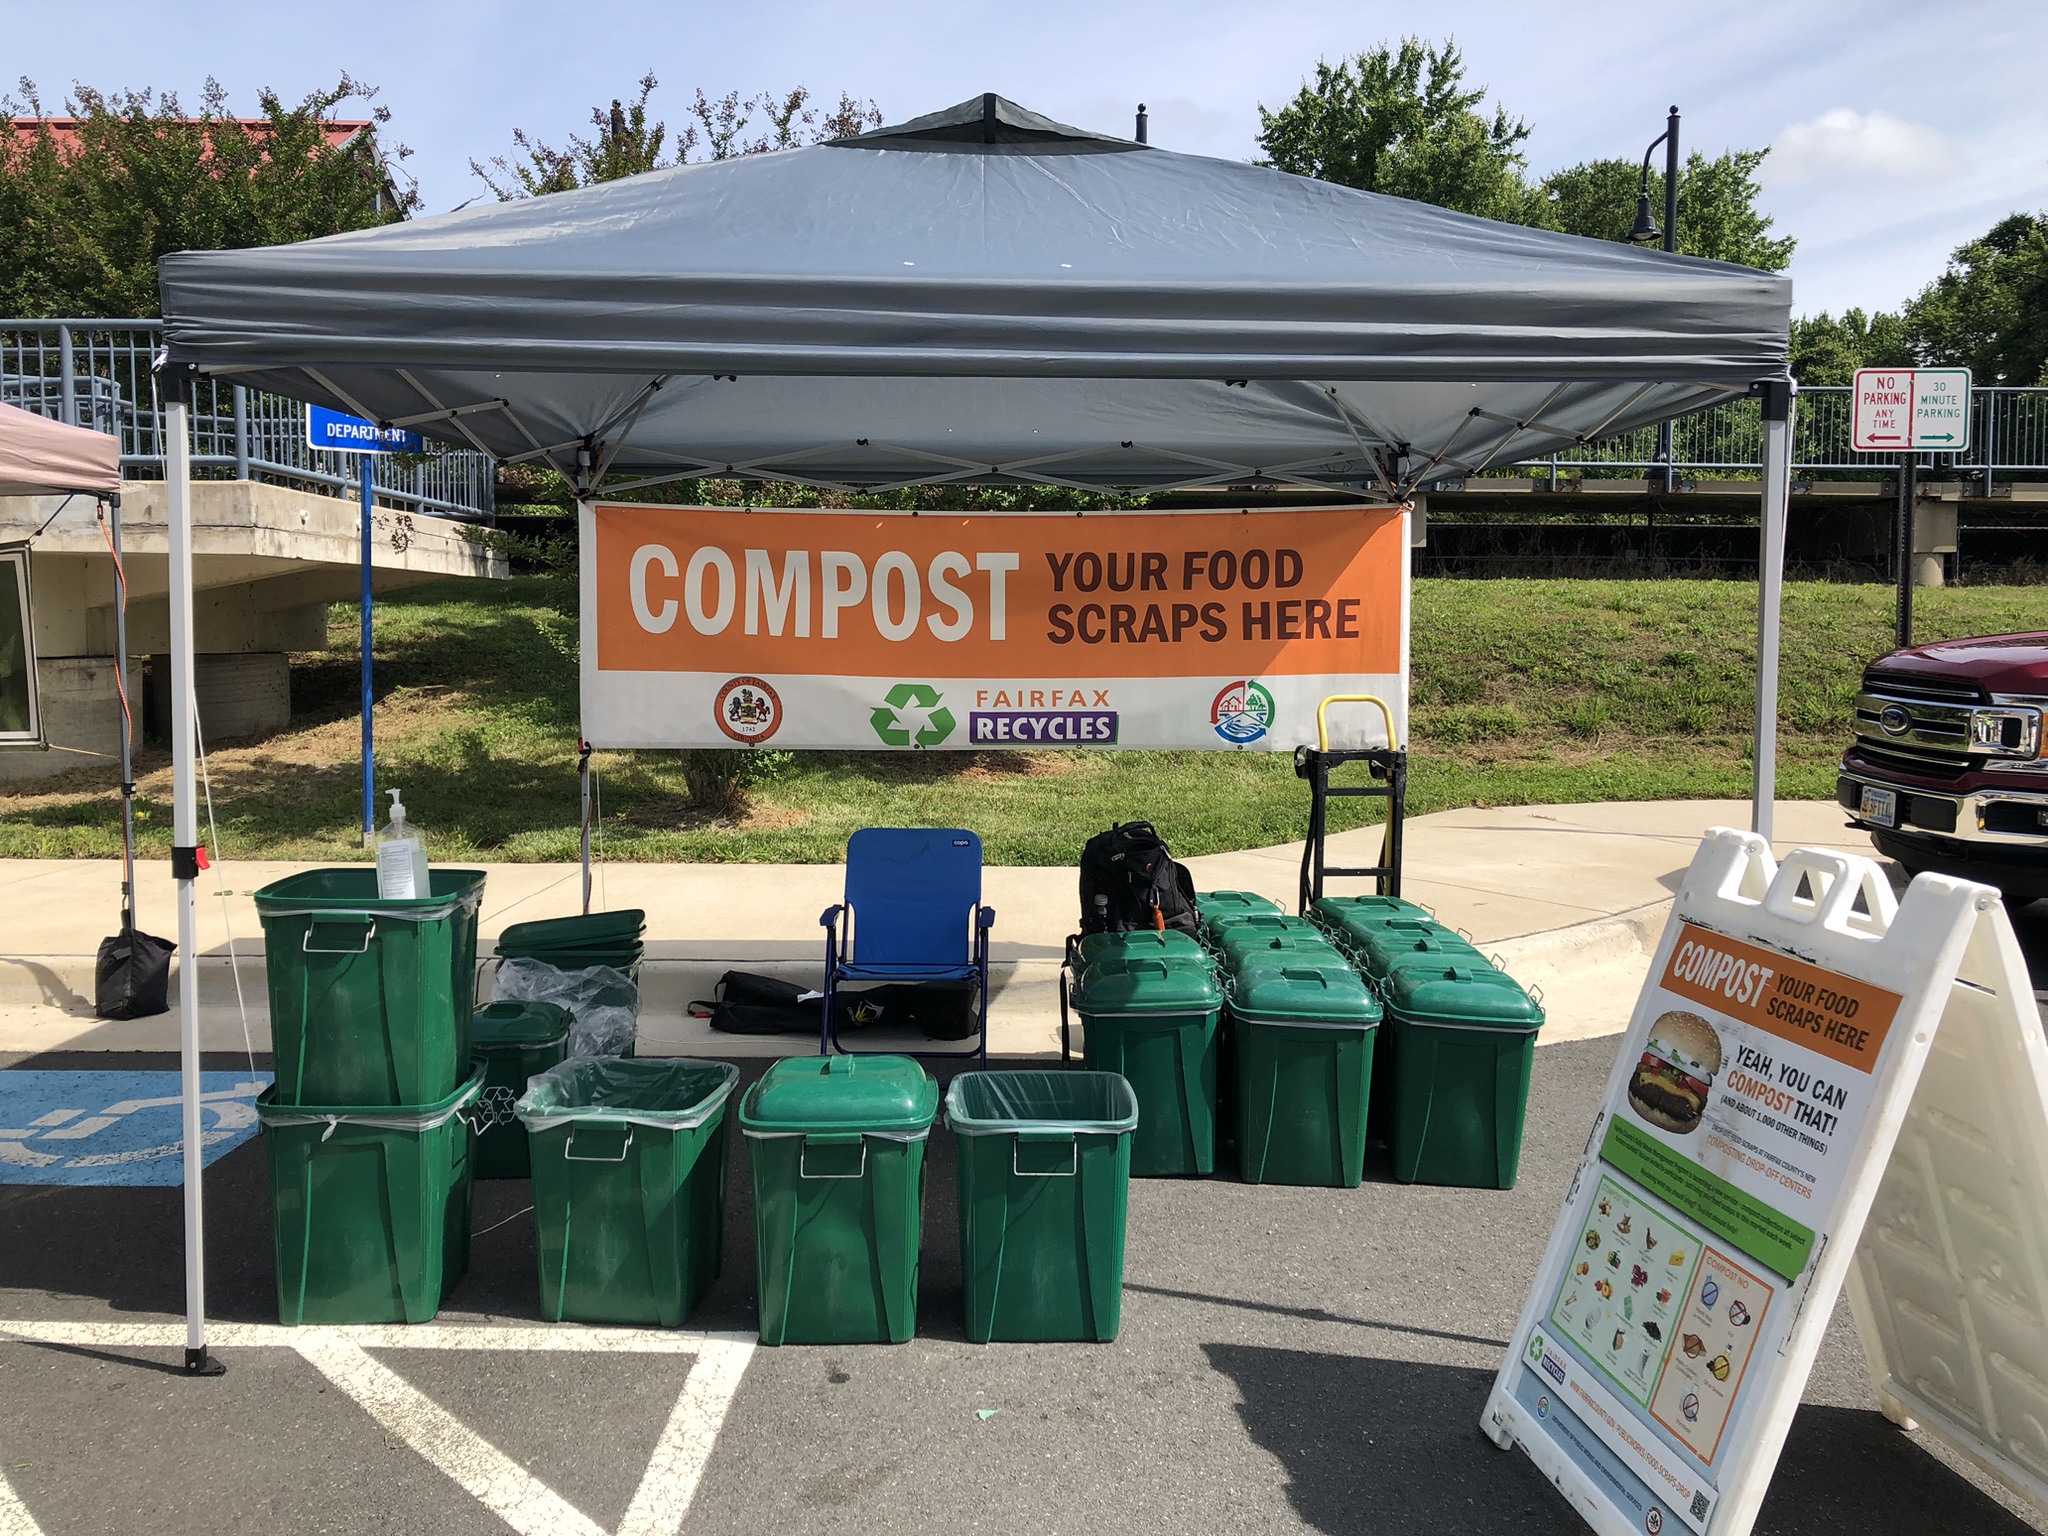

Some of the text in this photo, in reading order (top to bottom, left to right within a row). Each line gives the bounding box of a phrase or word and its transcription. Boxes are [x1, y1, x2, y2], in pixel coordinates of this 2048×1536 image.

[1864, 392, 1906, 405] PARKING
[1876, 377, 1895, 390] NO
[1920, 396, 1958, 405] MINUTE
[1933, 382, 1946, 392] 30
[1873, 420, 1896, 428] TIME
[1875, 410, 1894, 418] ANY
[1917, 408, 1960, 418] PARKING
[1045, 549, 1303, 592] YOUR FOOD
[629, 544, 1019, 642] COMPOST
[1046, 599, 1360, 644] SCRAPS HERE
[976, 690, 1110, 708] FAIRFAX
[976, 716, 1111, 740] RECYCLES
[1671, 939, 1774, 1009] COMPOST
[1774, 973, 1860, 1020] YOUR FOOD
[1764, 995, 1870, 1052] SCRAPS HERE
[1734, 1045, 1848, 1110] YEAH, YOU CAN
[1725, 1068, 1838, 1137] COMPOST THAT!
[1719, 1094, 1828, 1156] (AND ABOUT 1,000 OTHER THINGS)
[1705, 1134, 1812, 1200] COMPOSTING DROP-OFF CENTERS
[1740, 1139, 1758, 1153] SCRAPS
[1763, 1151, 1781, 1166] FAIRFAX
[1781, 1160, 1804, 1178] COUNTY'S
[1803, 1172, 1816, 1184] NEW
[1706, 1255, 1749, 1290] COMPOST NO
[1542, 1355, 1564, 1383] RECYCLES
[1546, 1346, 1567, 1370] FAIRFAX
